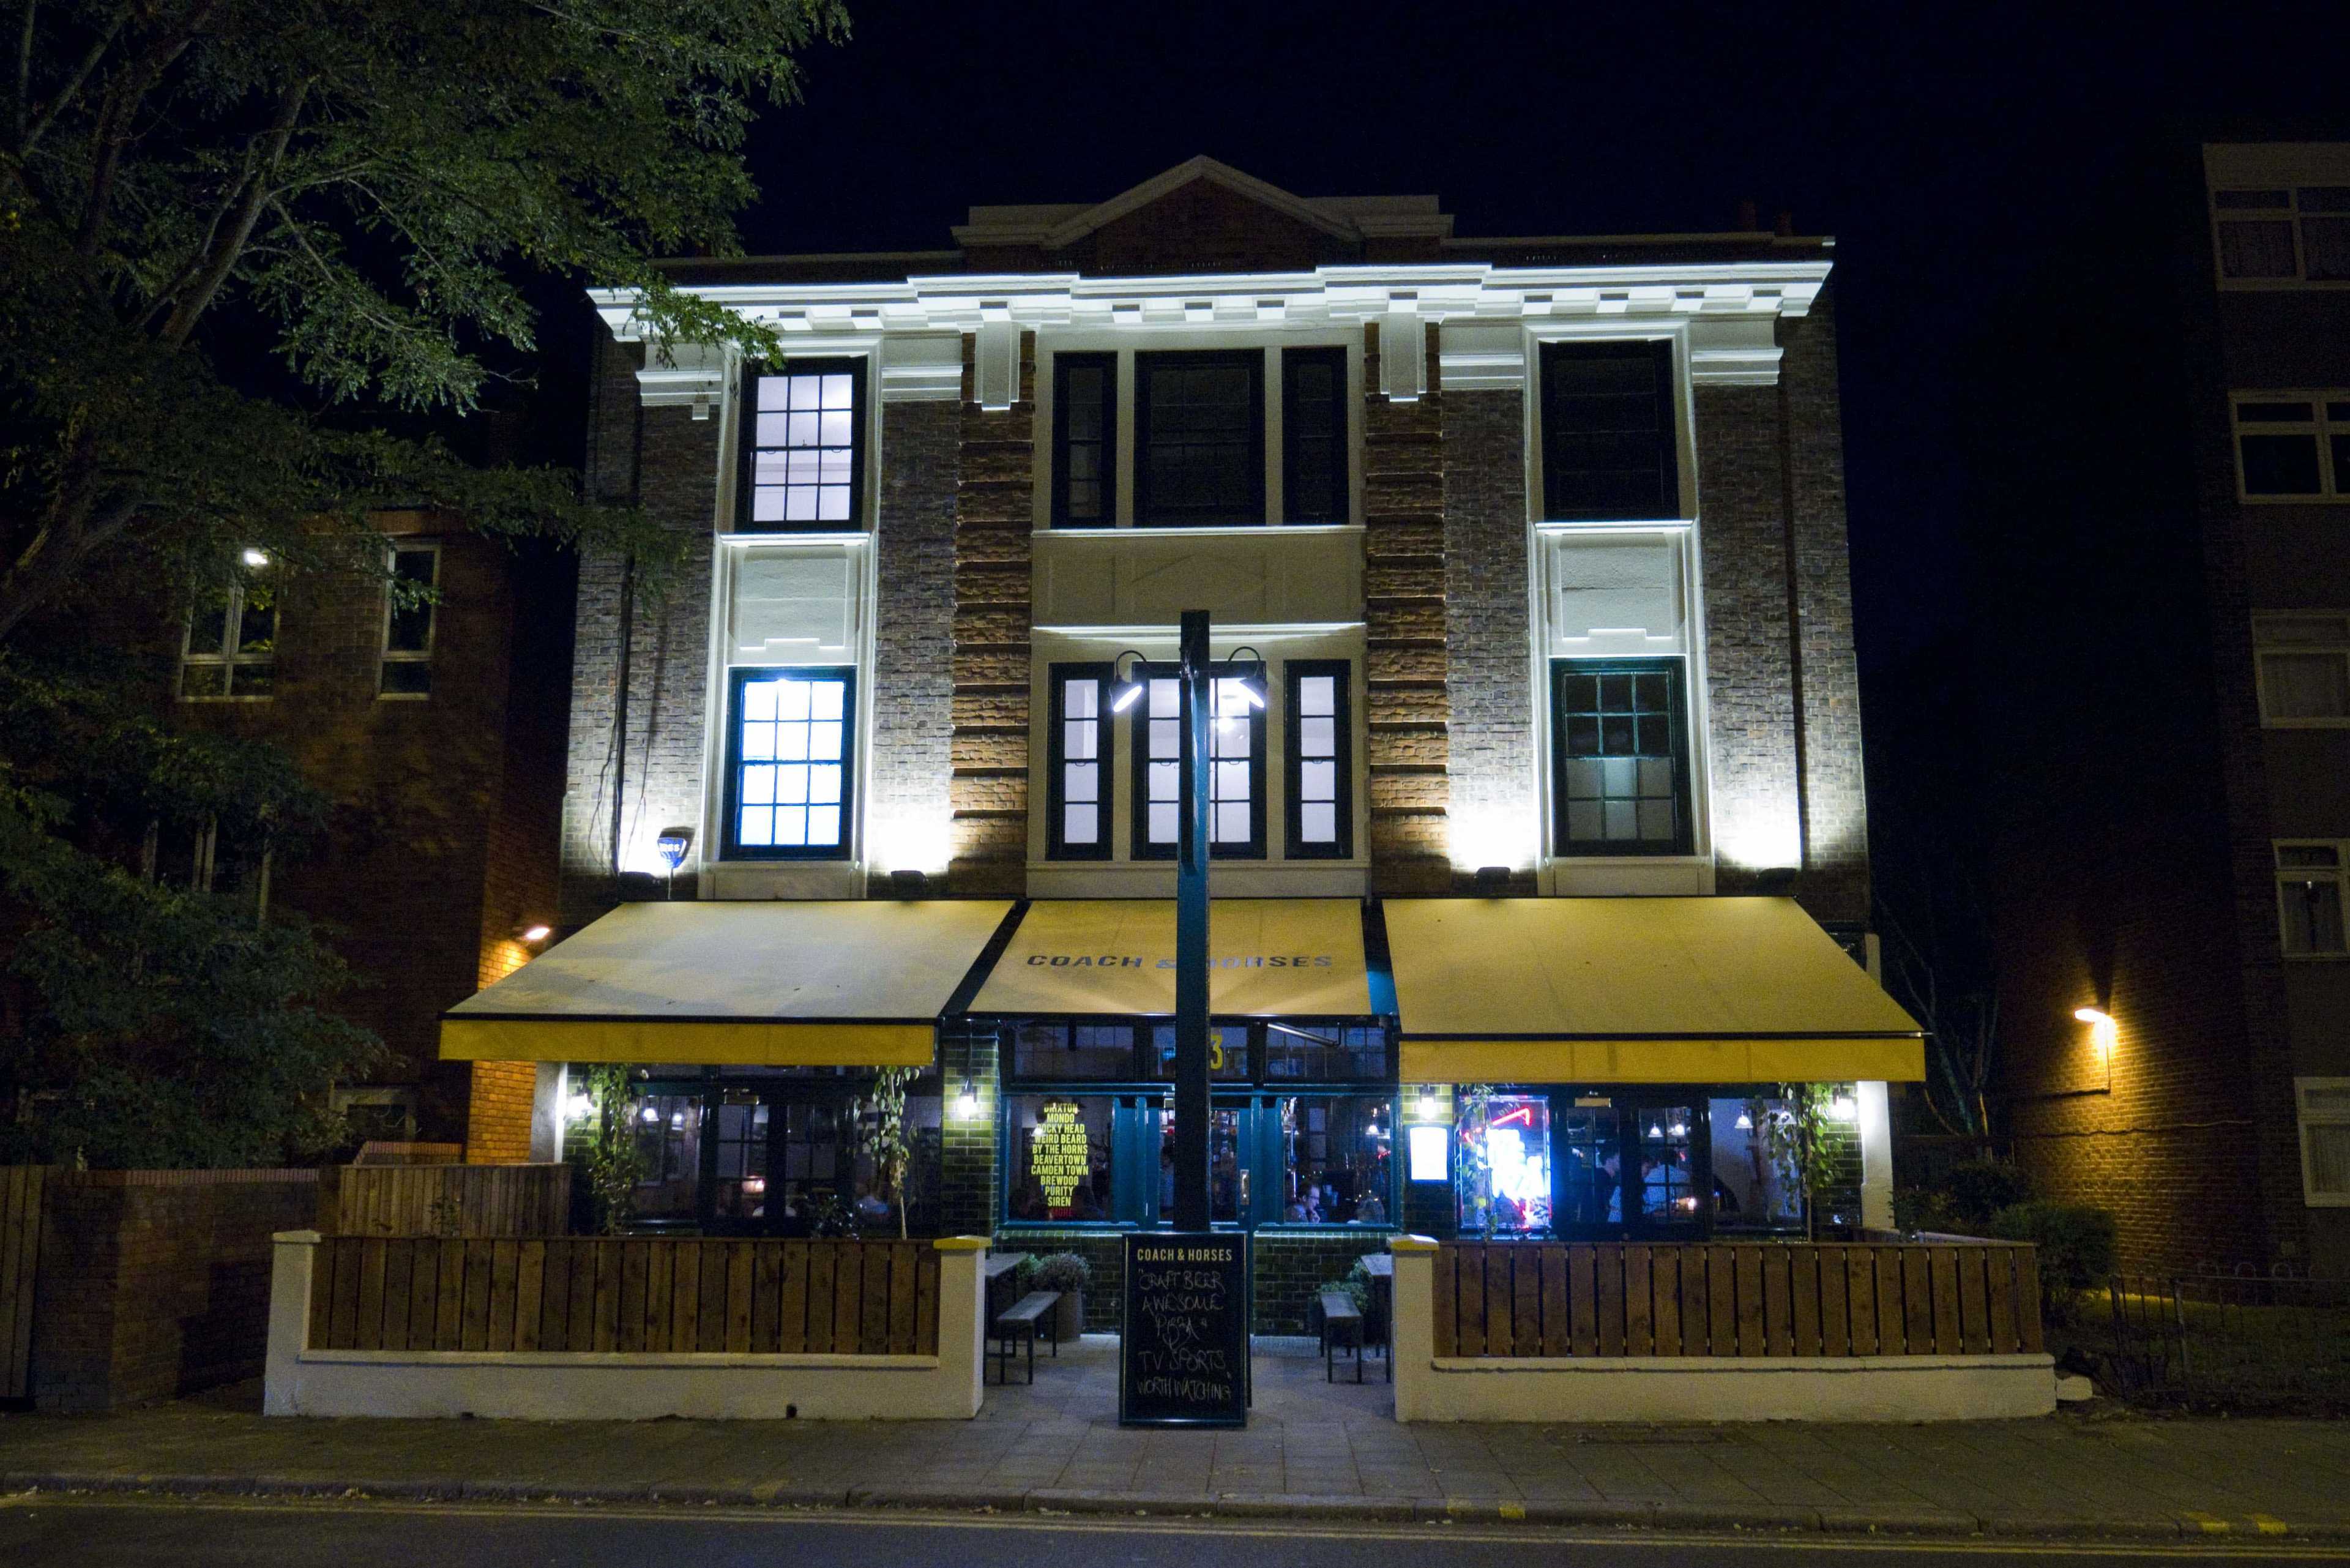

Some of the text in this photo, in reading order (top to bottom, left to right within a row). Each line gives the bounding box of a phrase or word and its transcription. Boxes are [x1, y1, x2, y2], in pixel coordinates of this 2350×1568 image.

[1026, 955, 1143, 968] COACH
[1046, 1113, 1075, 1124] MONDO
[1064, 1124, 1085, 1134] HEAD
[1034, 1134, 1087, 1144] WEIRD BEARD
[1032, 1144, 1088, 1154] BY THE HORNS
[1033, 1155, 1087, 1165] BEAVERTOWN
[1031, 1165, 1089, 1176] CAMDEN TOWN
[1040, 1176, 1079, 1186] BREWDOG
[1045, 1186, 1074, 1197] PURITY
[1047, 1197, 1072, 1207] SIREN
[1136, 1248, 1233, 1261] COACH & HORSES
[1183, 1271, 1226, 1294] BEER
[1141, 1293, 1225, 1316] AWESOME
[1137, 1348, 1226, 1375] TV SPORTS
